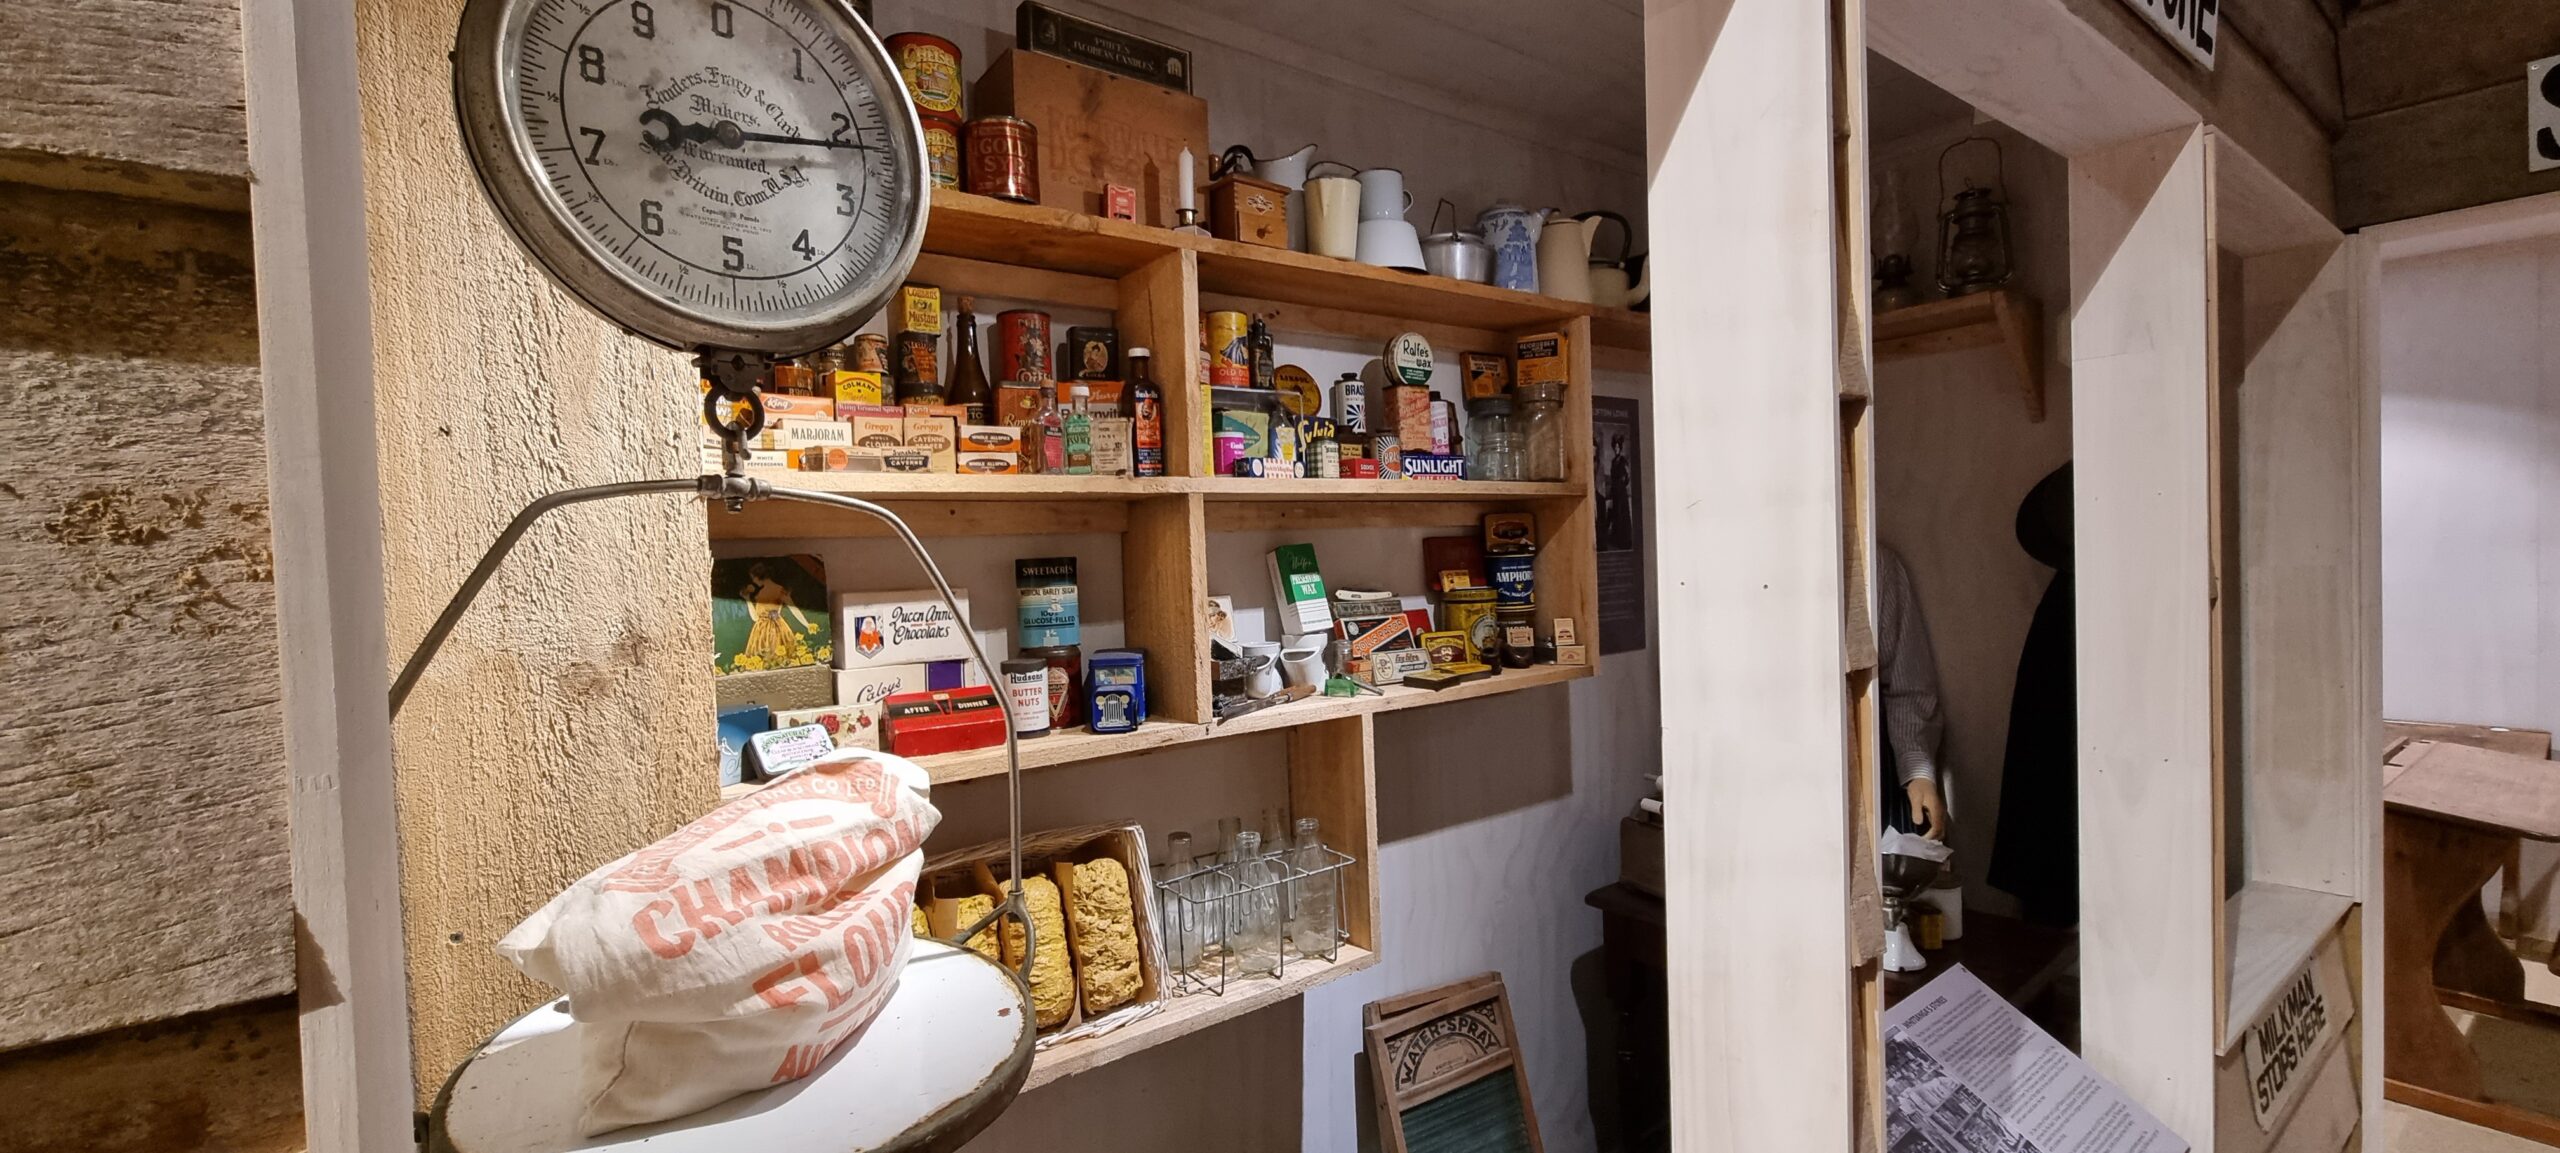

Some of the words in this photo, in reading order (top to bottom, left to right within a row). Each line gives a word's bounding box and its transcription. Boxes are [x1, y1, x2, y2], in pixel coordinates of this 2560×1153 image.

[631, 0, 655, 40] 9
[711, 2, 734, 39] 0
[578, 44, 606, 86] 8
[792, 48, 805, 82] 1
[830, 111, 851, 144] 2
[580, 126, 606, 166] 7
[836, 183, 855, 217] 3
[639, 199, 664, 237] 6
[722, 235, 744, 272] 5
[792, 229, 816, 261] 4
[1416, 359, 1432, 368] wax
[791, 428, 845, 441] MARJORAM
[1404, 457, 1464, 477] SUNLIGHT
[1022, 564, 1074, 577] SWEETACRES
[1300, 583, 1318, 595] WAX
[891, 606, 924, 624] Queen
[1023, 615, 1076, 625] GLUCOSE-FILLED
[889, 620, 951, 645] Chocolates
[904, 706, 930, 714] AFTER
[958, 700, 989, 709] DINNER
[1012, 686, 1043, 697] BUTTER
[1017, 697, 1040, 707] NUTS
[632, 815, 921, 960] CHAMPION
[752, 881, 915, 1012] FLOUR
[2258, 968, 2315, 1064] MILKMAN
[1401, 1016, 1497, 1085] WATER-SPRAY
[2256, 1030, 2298, 1115] STOPS
[2295, 994, 2326, 1058] HERE
